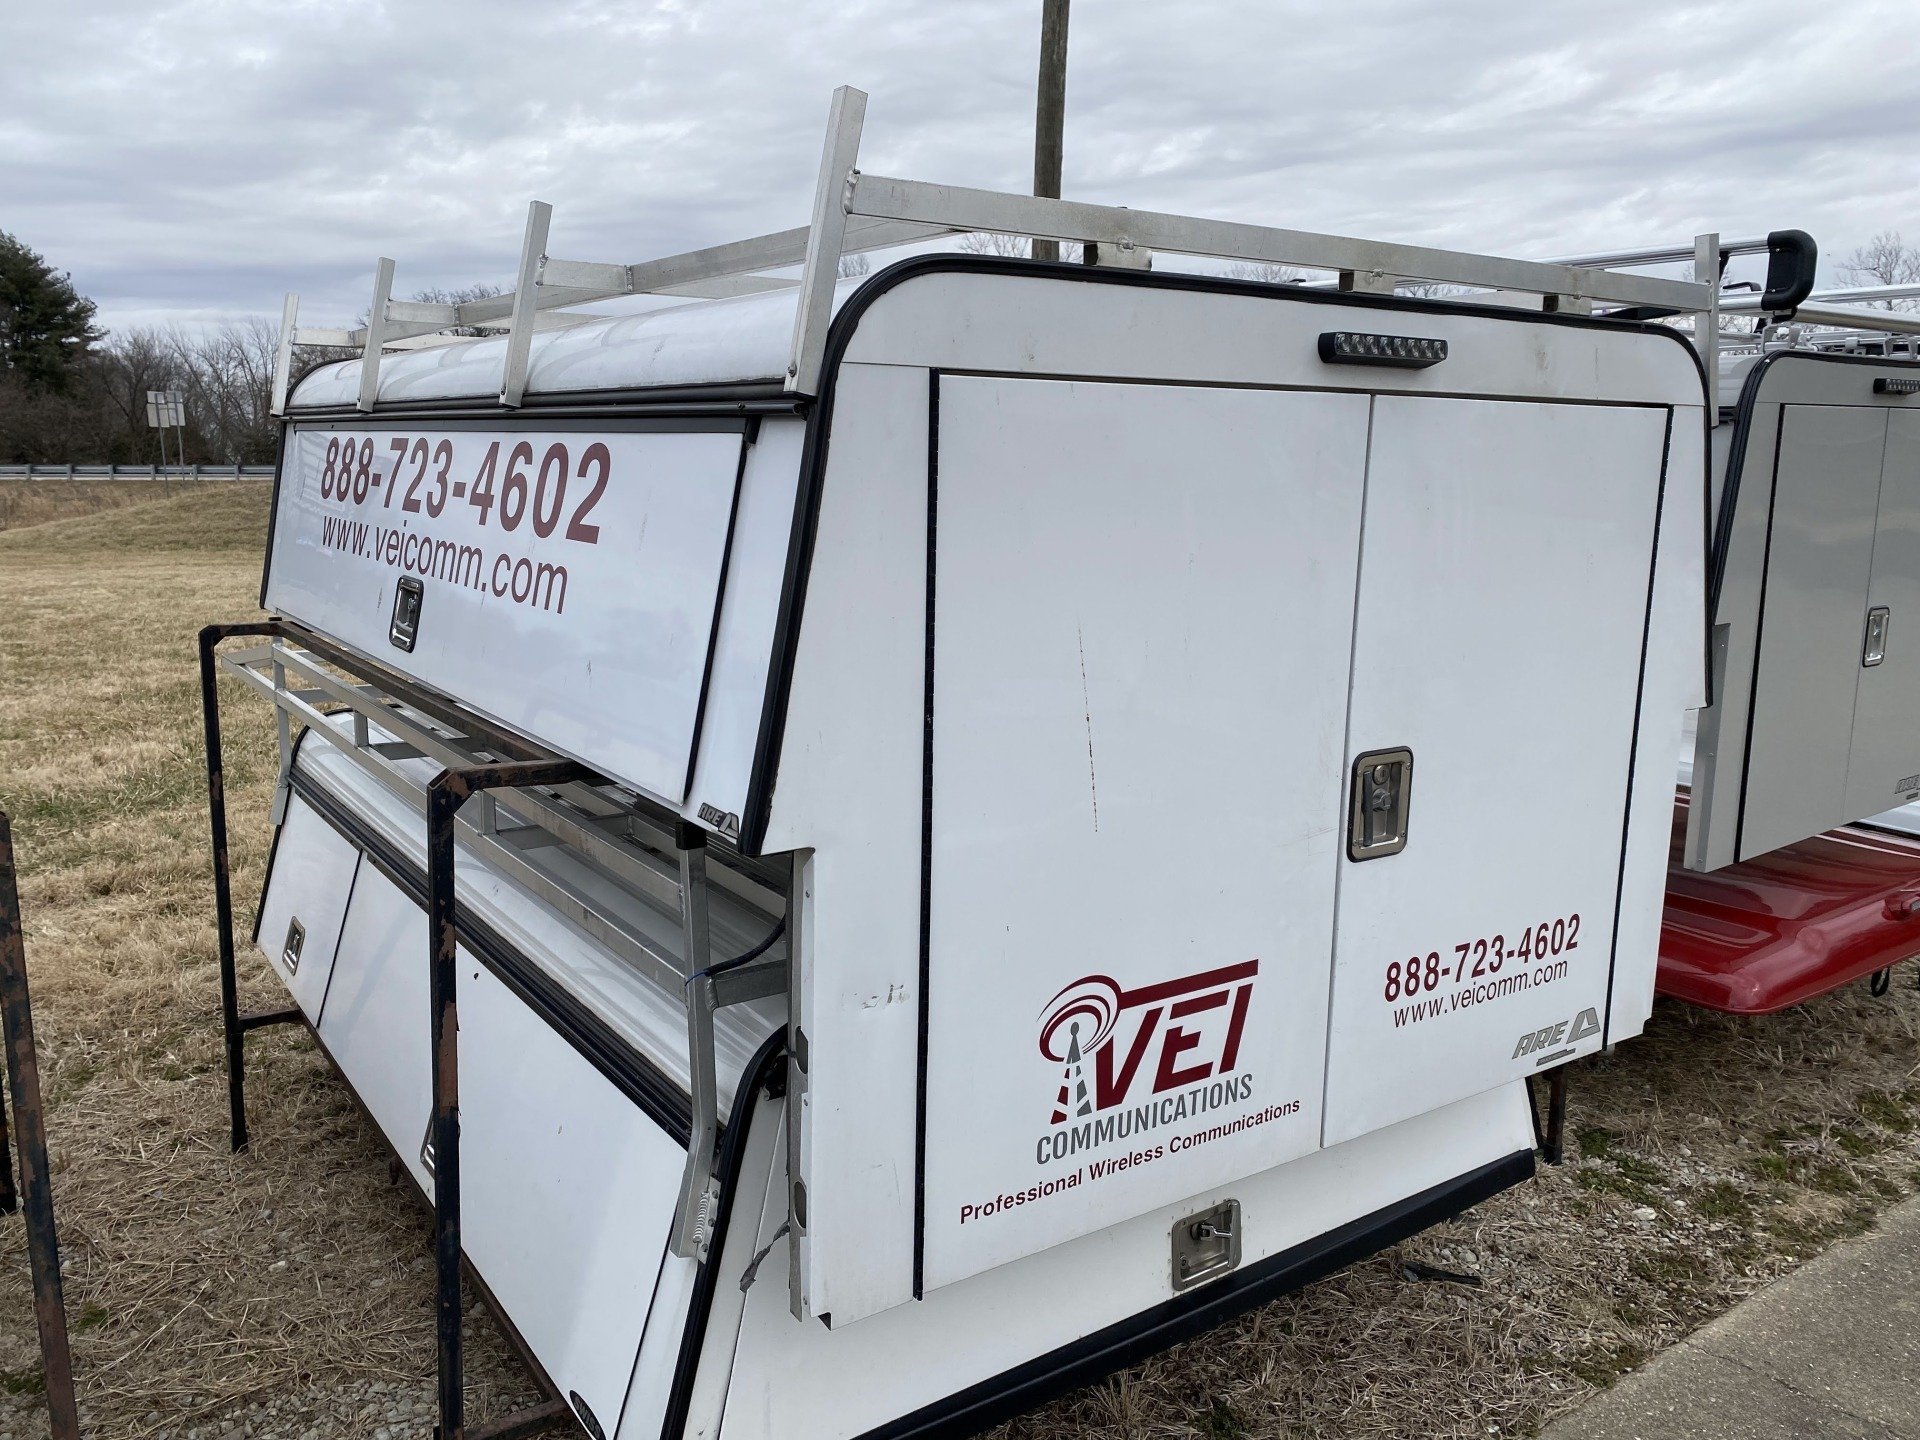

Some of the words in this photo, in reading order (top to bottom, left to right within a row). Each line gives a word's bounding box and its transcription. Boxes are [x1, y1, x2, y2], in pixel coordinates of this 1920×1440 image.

[321, 436, 611, 544] 888-723-4602
[322, 514, 568, 613] www.veicomm.com
[1384, 913, 1581, 1002] 888-723-4602
[1394, 960, 1568, 1028] www.veicomm.com
[1096, 959, 1259, 1111] VEI
[960, 1168, 1083, 1224] Professional
[1089, 1145, 1164, 1178] Wireless
[1169, 1099, 1300, 1153] Communications
[1036, 1073, 1254, 1165] COMMUNICATIONS
